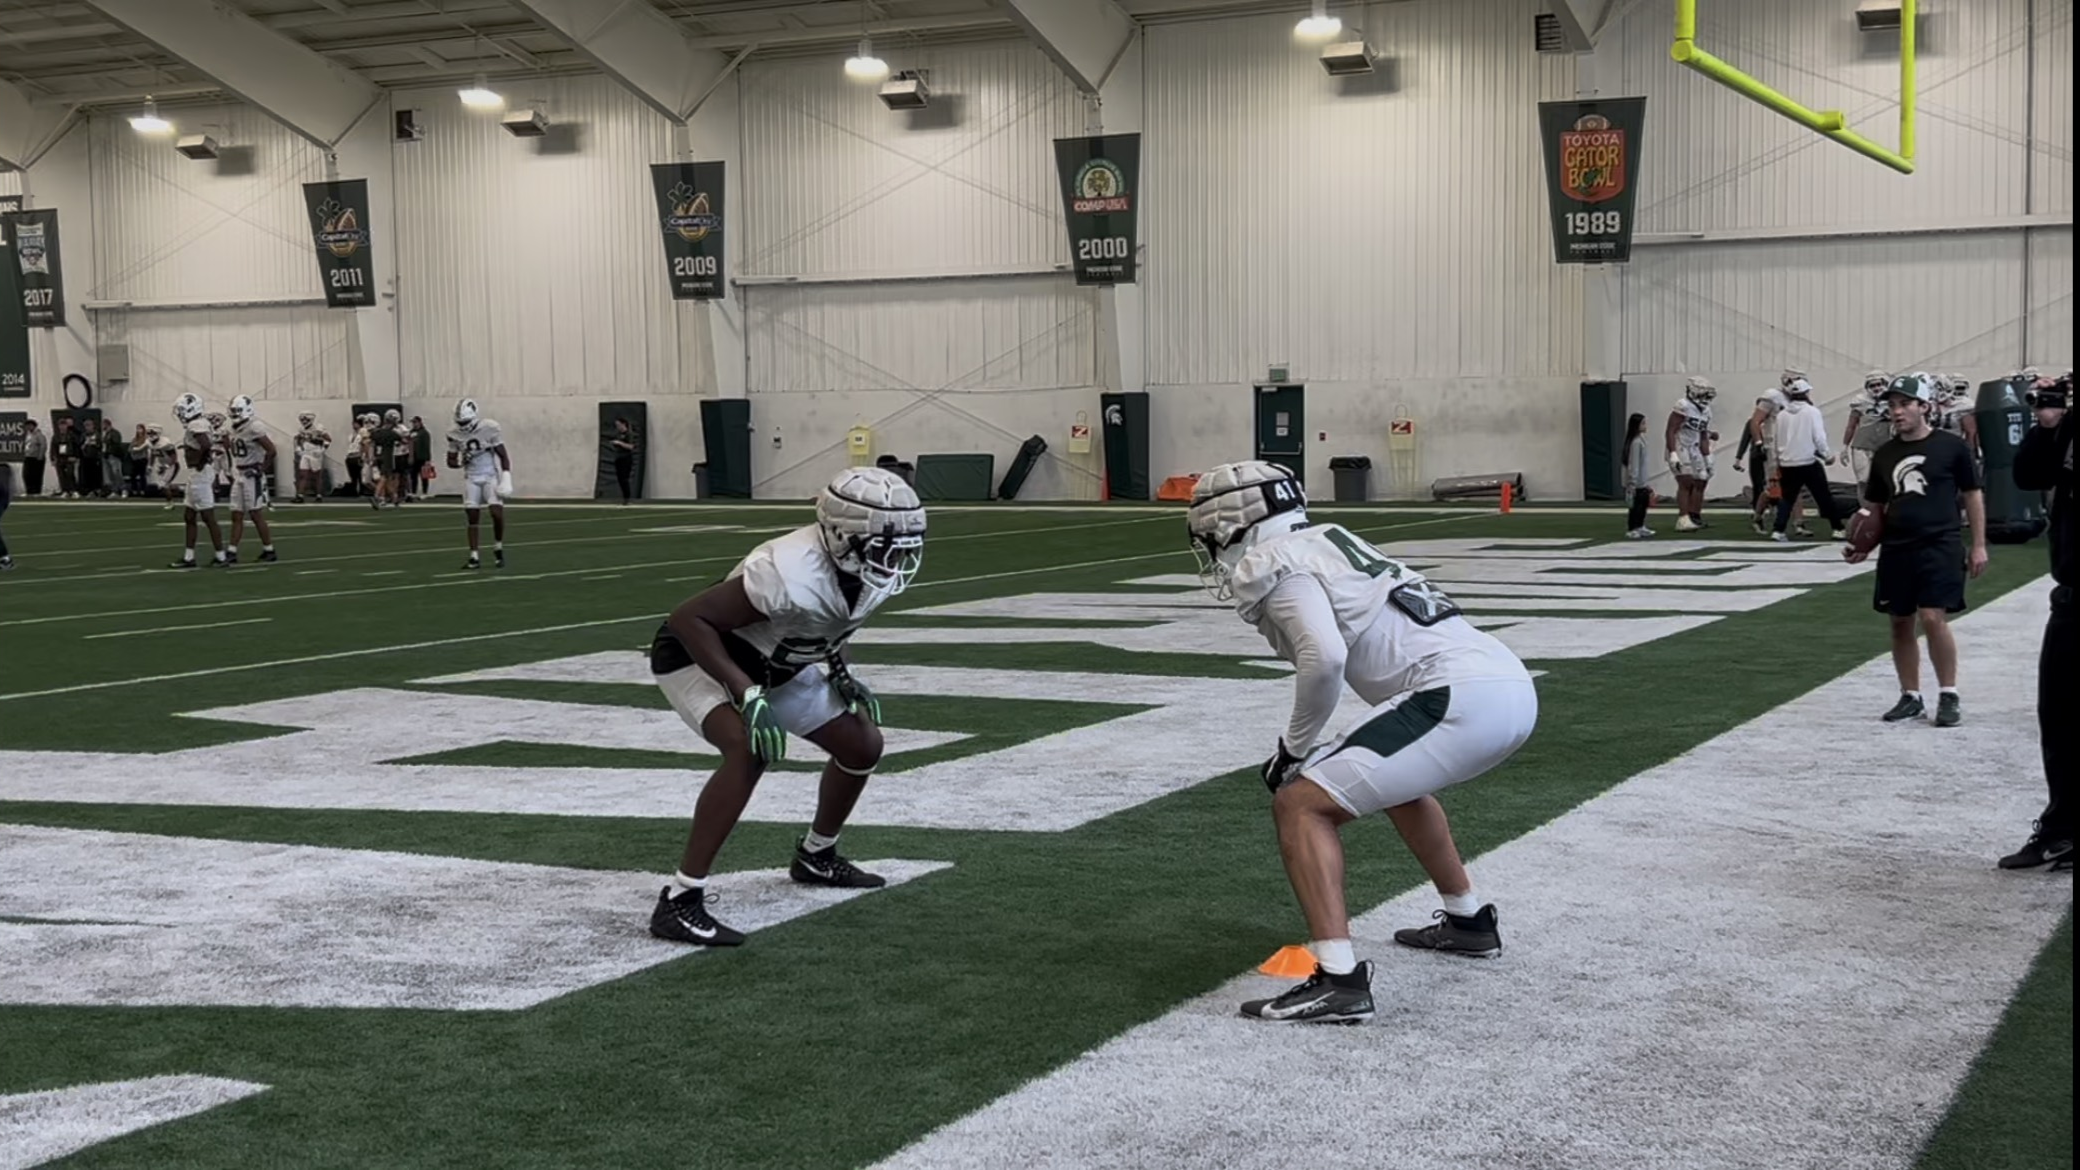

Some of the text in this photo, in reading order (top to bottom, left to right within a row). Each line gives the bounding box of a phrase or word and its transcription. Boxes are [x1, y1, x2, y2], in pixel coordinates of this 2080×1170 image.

[1564, 134, 1620, 146] TOYOTA
[1564, 146, 1619, 167] GATOR
[1569, 167, 1616, 188] BOWL
[1565, 211, 1621, 235] 1989
[1079, 237, 1128, 260] 2000
[674, 256, 717, 276] 2009
[330, 268, 364, 287] 2011
[23, 288, 54, 307] 2017
[2, 373, 25, 385] 2014
[1274, 480, 1296, 501] 41
[1322, 526, 1402, 581] 4
